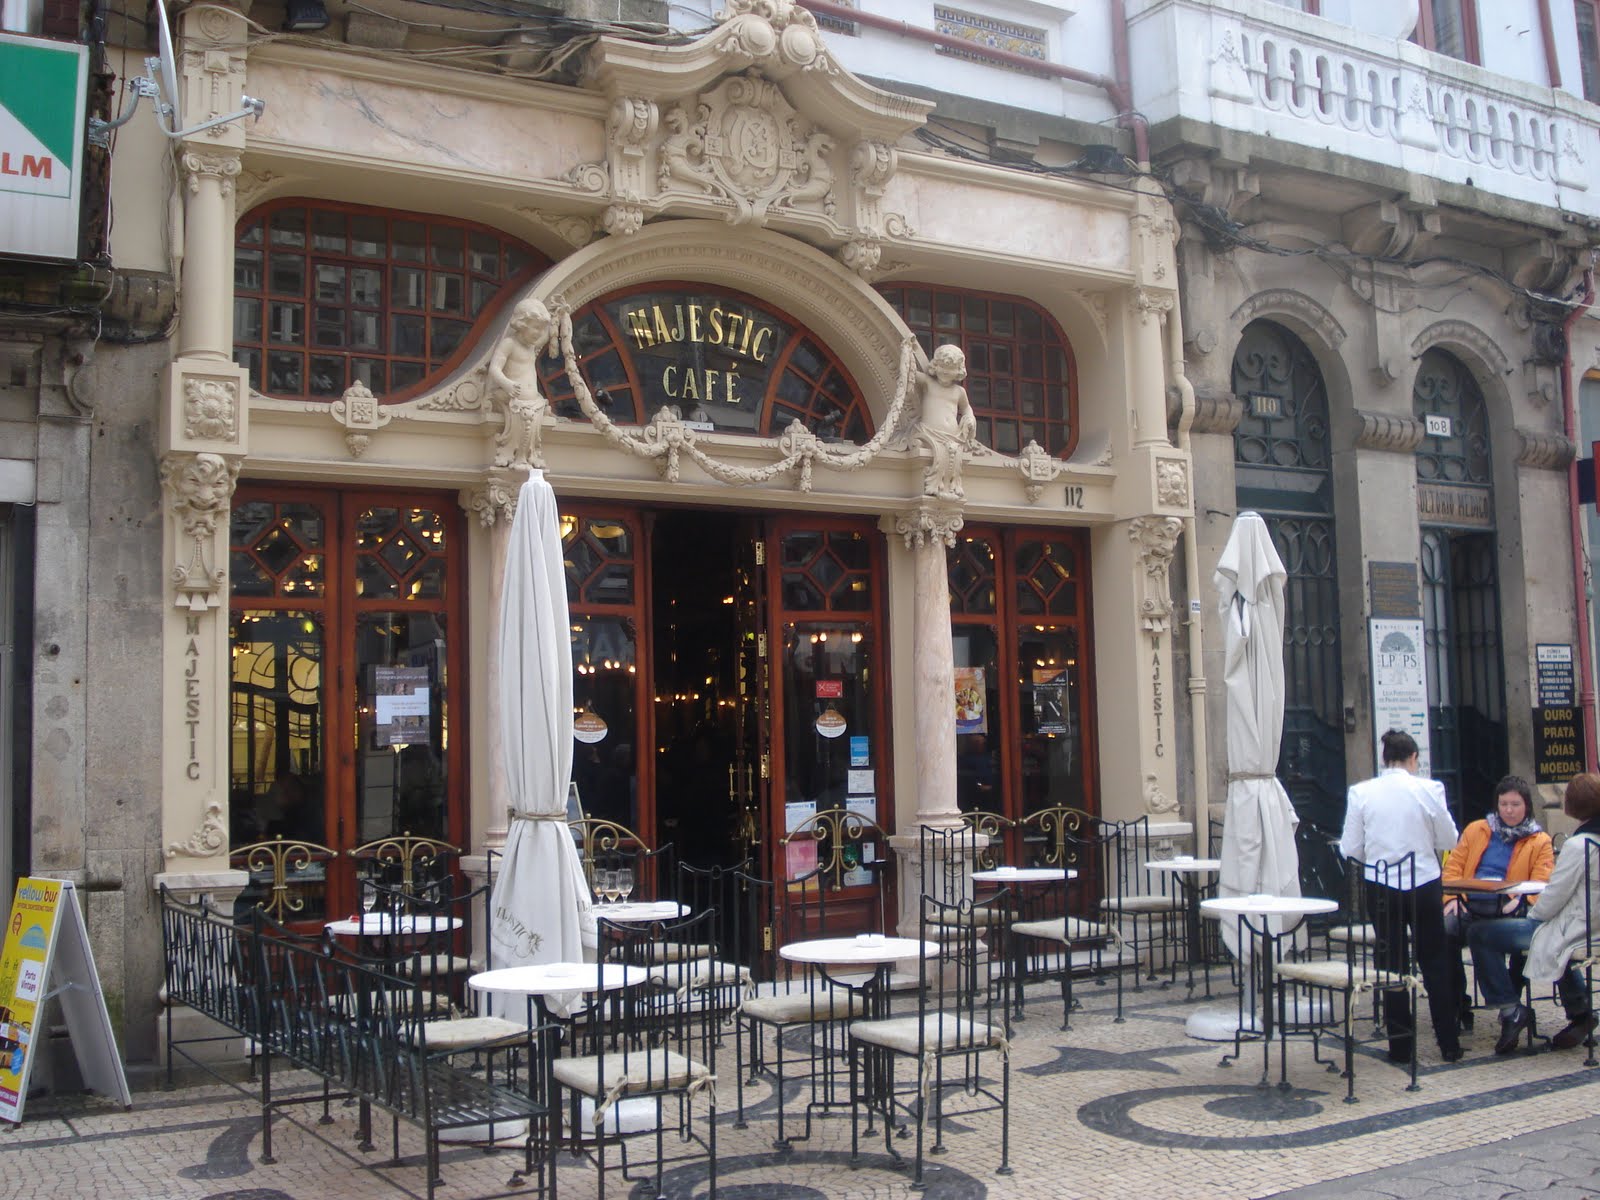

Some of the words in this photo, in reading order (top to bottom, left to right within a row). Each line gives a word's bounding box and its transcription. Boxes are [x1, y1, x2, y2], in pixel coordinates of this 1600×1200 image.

[1, 152, 52, 179] LM
[628, 304, 773, 363] MAJESTIC
[662, 361, 742, 403] CAFÉ
[1257, 396, 1277, 414] 110
[1429, 420, 1447, 433] 108
[1064, 486, 1084, 509] 112
[1381, 654, 1395, 668] LP
[1403, 654, 1417, 668] PS
[185, 616, 200, 781] MAJESTIC
[1151, 636, 1164, 758] MAJESTIC
[1544, 709, 1572, 721] OURO
[1544, 727, 1575, 738] PRATA
[1545, 742, 1575, 756] JÓIAS
[1540, 762, 1581, 773] MOEDAS
[44, 886, 57, 902] bus
